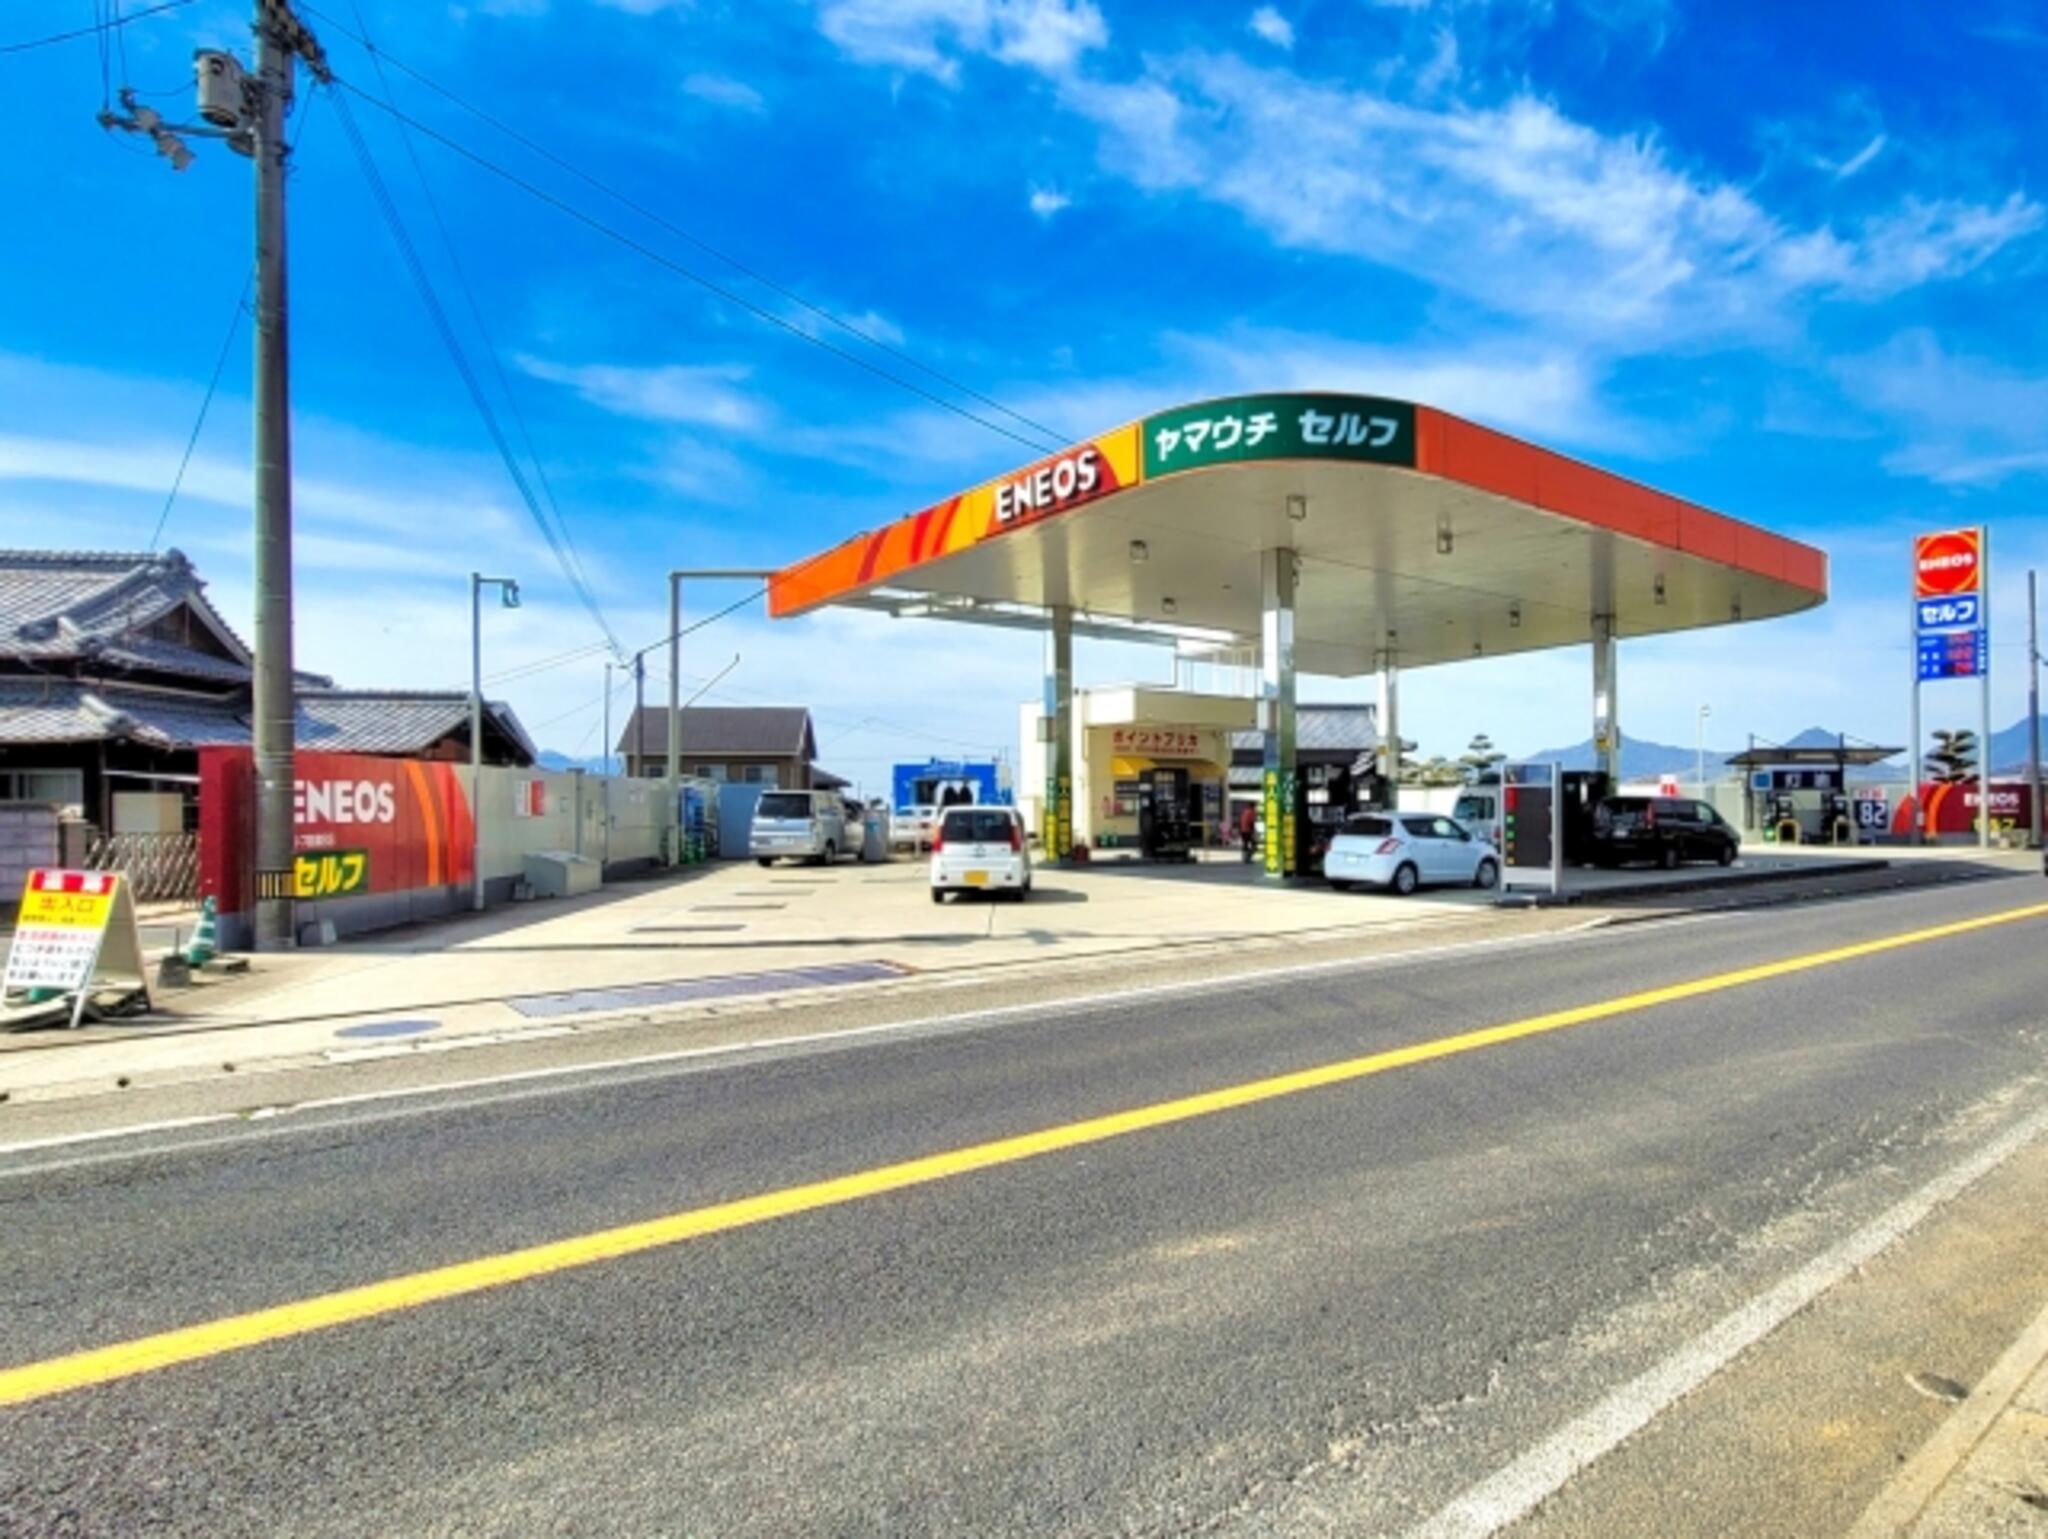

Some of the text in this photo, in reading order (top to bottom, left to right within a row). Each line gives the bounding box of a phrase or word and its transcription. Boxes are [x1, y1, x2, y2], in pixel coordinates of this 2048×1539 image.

[1155, 409, 1398, 461] ヤマウチ セルフ
[996, 450, 1097, 520] ENEOS
[1919, 553, 1974, 571] ENEOS
[1921, 602, 1975, 625] セルフ
[294, 780, 395, 823] ENEOS
[1860, 802, 1886, 825] 82
[294, 854, 365, 897] セルフ
